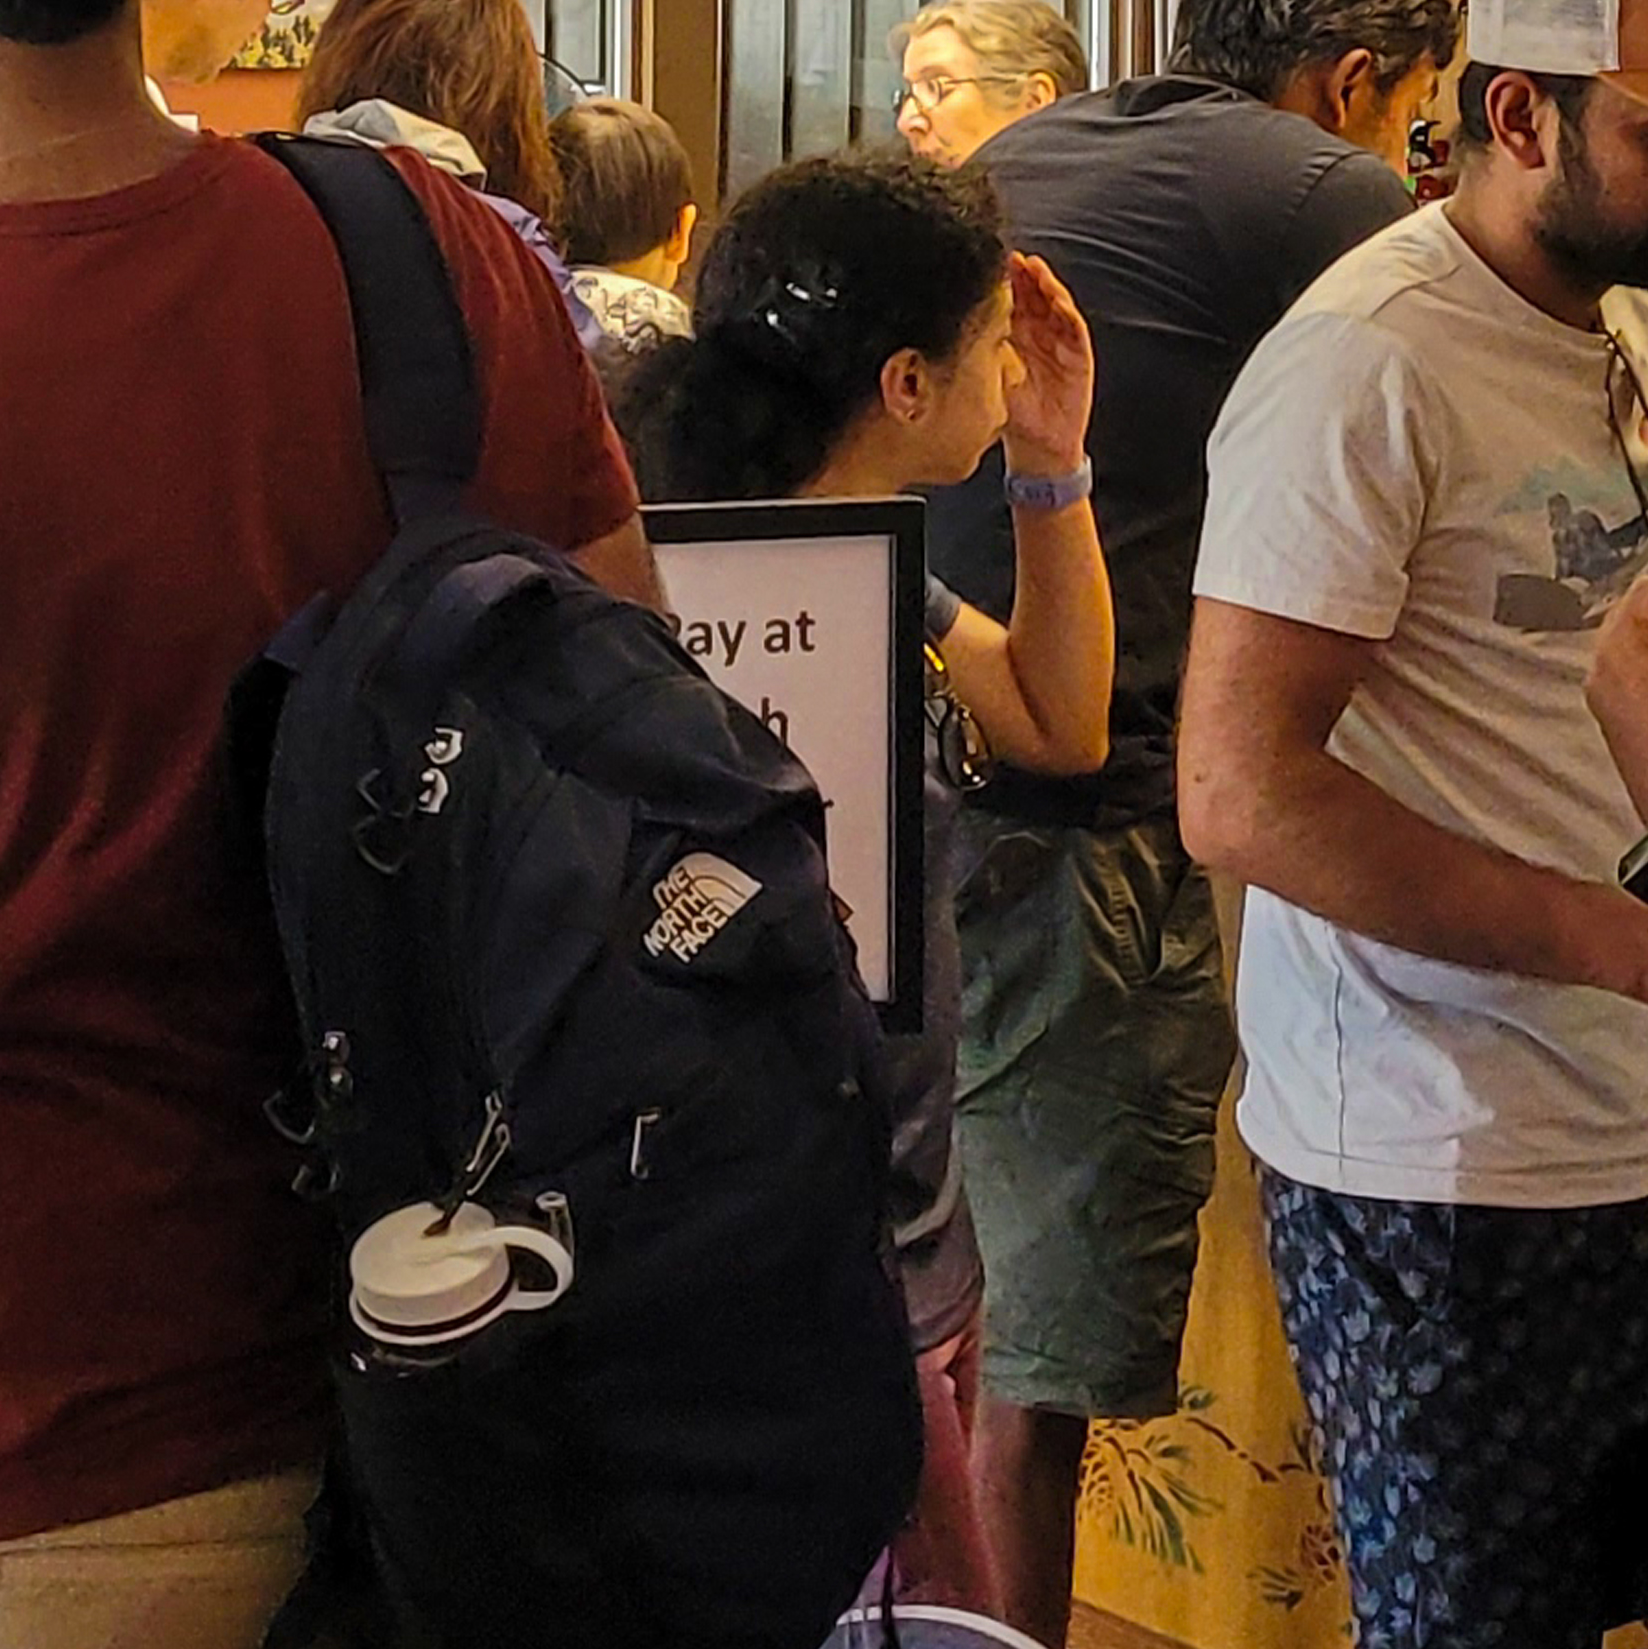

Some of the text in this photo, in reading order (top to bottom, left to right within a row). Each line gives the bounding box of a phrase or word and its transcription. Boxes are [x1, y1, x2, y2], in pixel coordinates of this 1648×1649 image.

[763, 610, 817, 654] at
[653, 864, 692, 910] THE
[643, 884, 709, 958] NORTH
[669, 903, 729, 964] FACE
